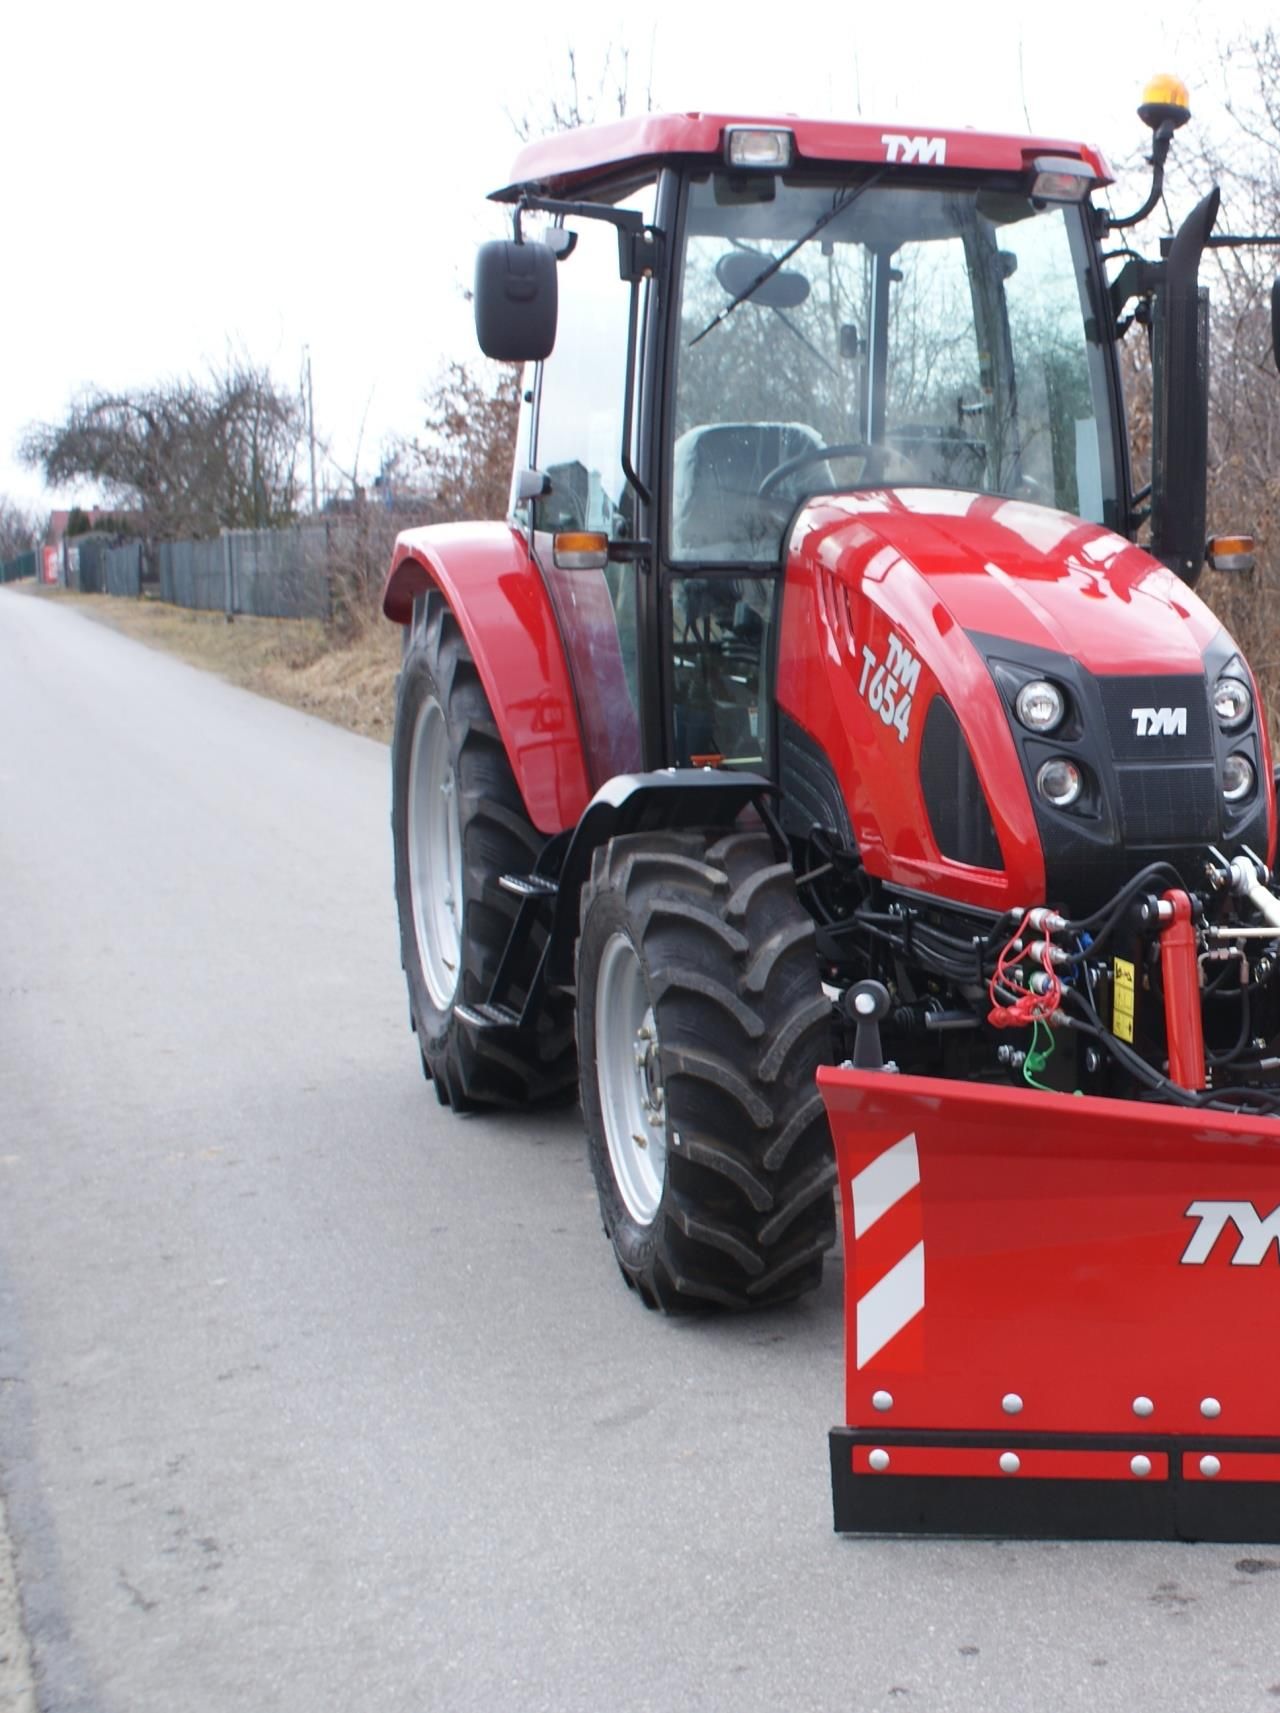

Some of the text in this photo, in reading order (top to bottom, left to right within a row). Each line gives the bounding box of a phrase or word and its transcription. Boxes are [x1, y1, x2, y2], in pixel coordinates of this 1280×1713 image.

[881, 134, 946, 165] TYM
[885, 632, 921, 696] TYM
[858, 645, 912, 743] T654
[1131, 707, 1187, 736] TYM
